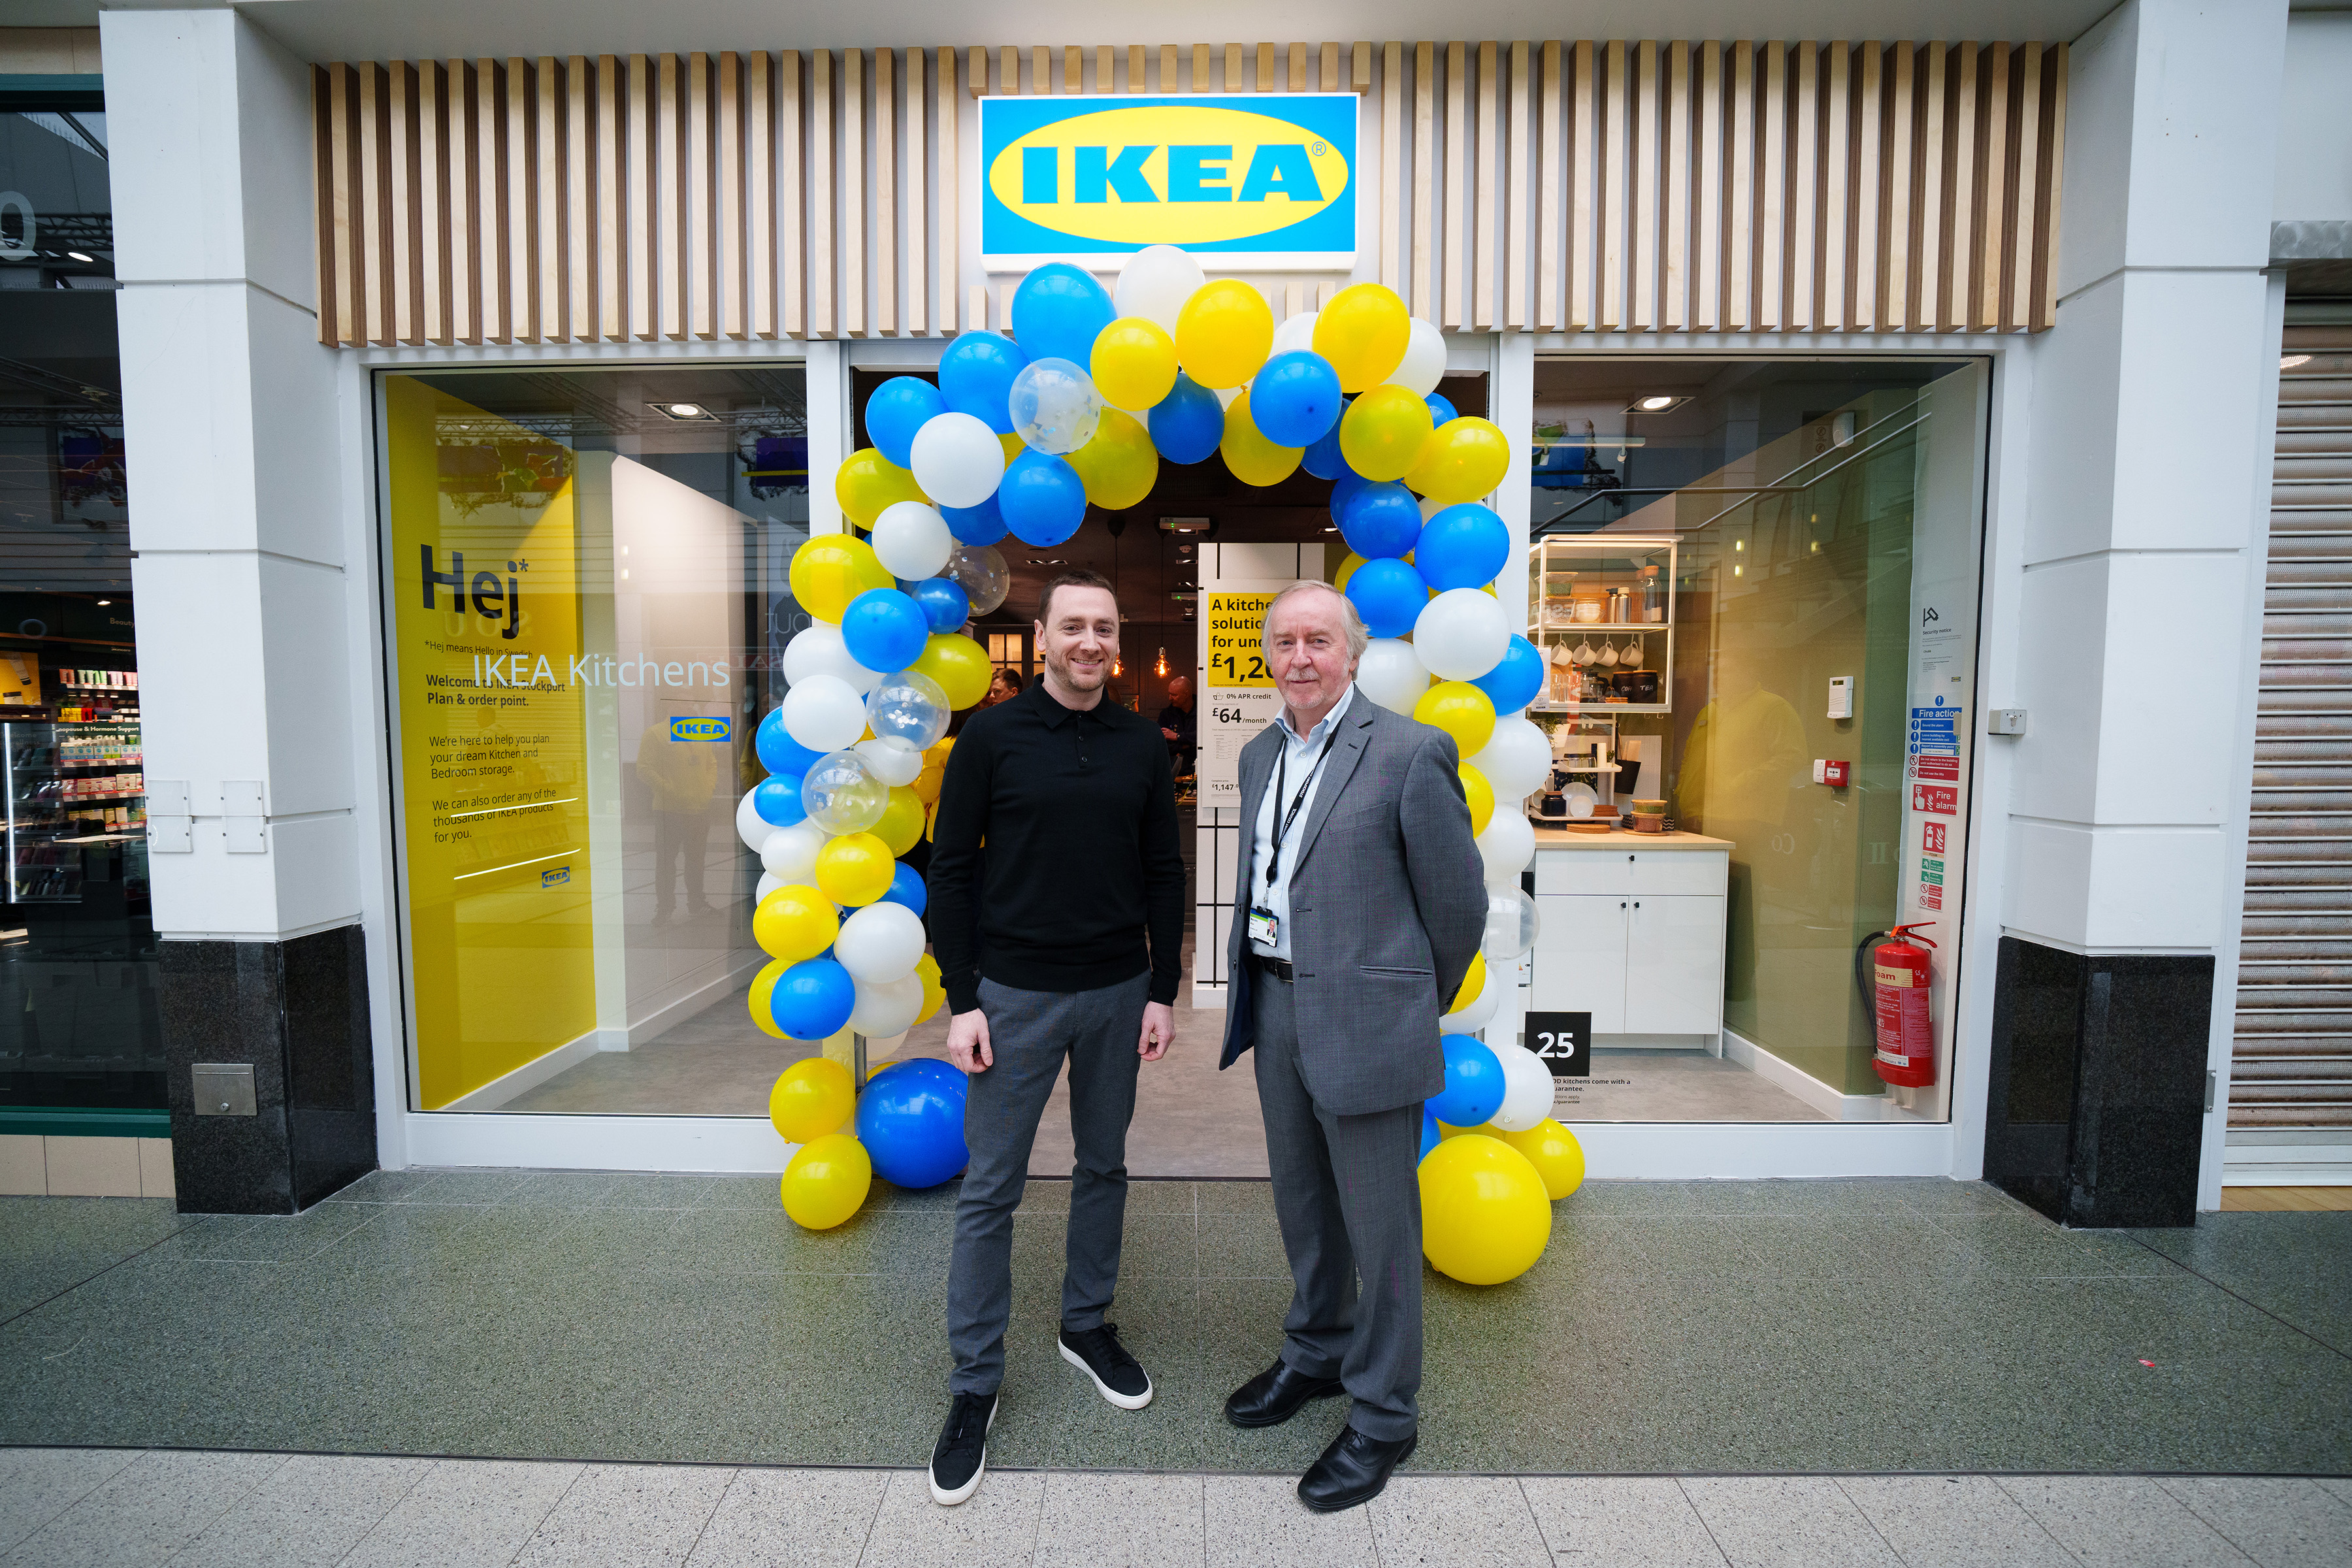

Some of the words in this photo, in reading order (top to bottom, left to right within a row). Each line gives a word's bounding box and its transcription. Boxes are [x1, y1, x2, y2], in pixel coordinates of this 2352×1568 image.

[1022, 144, 1326, 204] IKEA
[1211, 599, 1222, 611] A
[110, 617, 135, 629] Beauty
[1212, 635, 1233, 647] for
[446, 644, 474, 653] means
[475, 645, 495, 655] Hello
[497, 647, 503, 656] in
[474, 654, 557, 687] IKEA
[570, 652, 730, 687] Kitchens
[428, 693, 453, 704] Plan
[457, 693, 465, 705] &
[468, 694, 497, 706] order
[500, 696, 529, 708] point.
[1919, 709, 1934, 717] Fire
[1935, 709, 1960, 718] actio
[677, 724, 726, 734] IKEA
[459, 736, 481, 746] here
[483, 736, 493, 745] to
[495, 734, 514, 747] help
[515, 736, 531, 747] you
[533, 734, 549, 745] plan
[430, 753, 453, 766] your
[456, 751, 487, 762] dream
[489, 749, 521, 760] Kitchen
[523, 748, 538, 758] and
[431, 768, 476, 779] Bedroom
[480, 764, 515, 776] storage.
[1299, 776, 1311, 798] STOCKPORT
[433, 800, 449, 811] We
[451, 799, 468, 809] can
[471, 796, 489, 806] also
[492, 793, 515, 804] order
[517, 792, 532, 803] any
[534, 789, 542, 799] of
[544, 788, 557, 798] the
[1936, 791, 1951, 800] Fire
[1936, 802, 1957, 811] alarm
[433, 811, 485, 827] thousands
[487, 810, 496, 820] of
[498, 808, 517, 818] IKEA
[519, 802, 554, 818] products
[434, 832, 448, 843] for
[451, 830, 472, 843] you.
[544, 871, 568, 883] IKEA
[1537, 1032, 1575, 1058] 25
